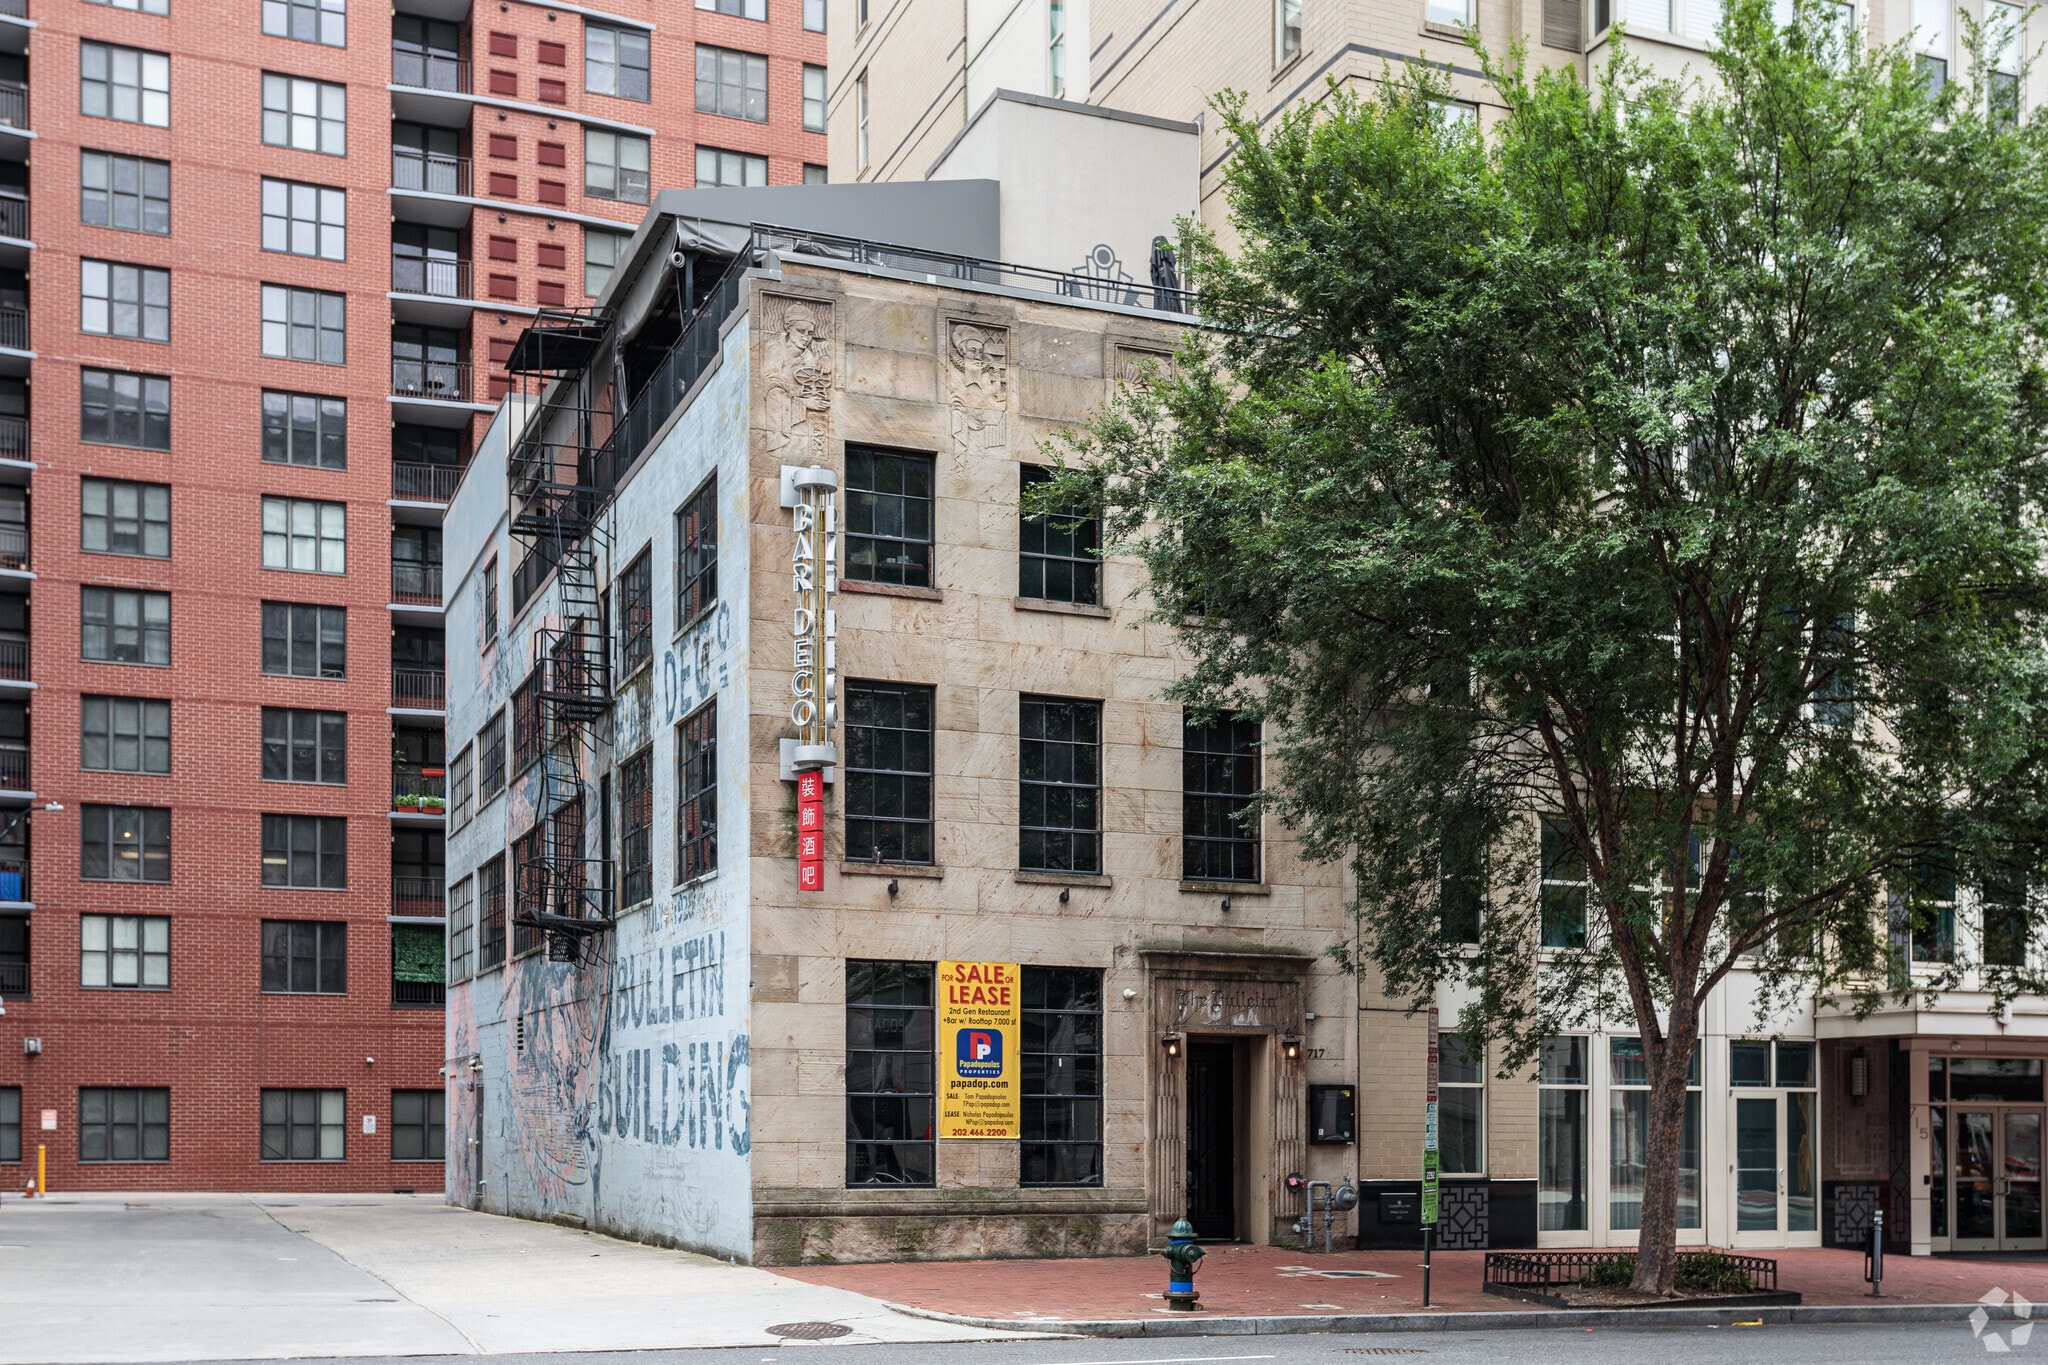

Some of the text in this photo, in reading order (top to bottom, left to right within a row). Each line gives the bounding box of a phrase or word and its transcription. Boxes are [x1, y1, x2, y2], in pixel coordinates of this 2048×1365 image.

[791, 503, 816, 727] BAR DECO
[801, 777, 816, 886] 裝飾酒吧
[617, 930, 725, 1031] BULLETIN
[941, 964, 1014, 985] FOR SALE OR
[949, 985, 1011, 1006] LEASE
[949, 1007, 1011, 1016] 2nd Gen Restaurant
[968, 1018, 993, 1026] Rooftop
[1307, 1048, 1325, 1059] 717
[951, 1079, 1009, 1089] papadop.com
[599, 1034, 751, 1156] BUILDING
[952, 1128, 1007, 1136] 202.466.2200
[1910, 1106, 1929, 1140] 715
